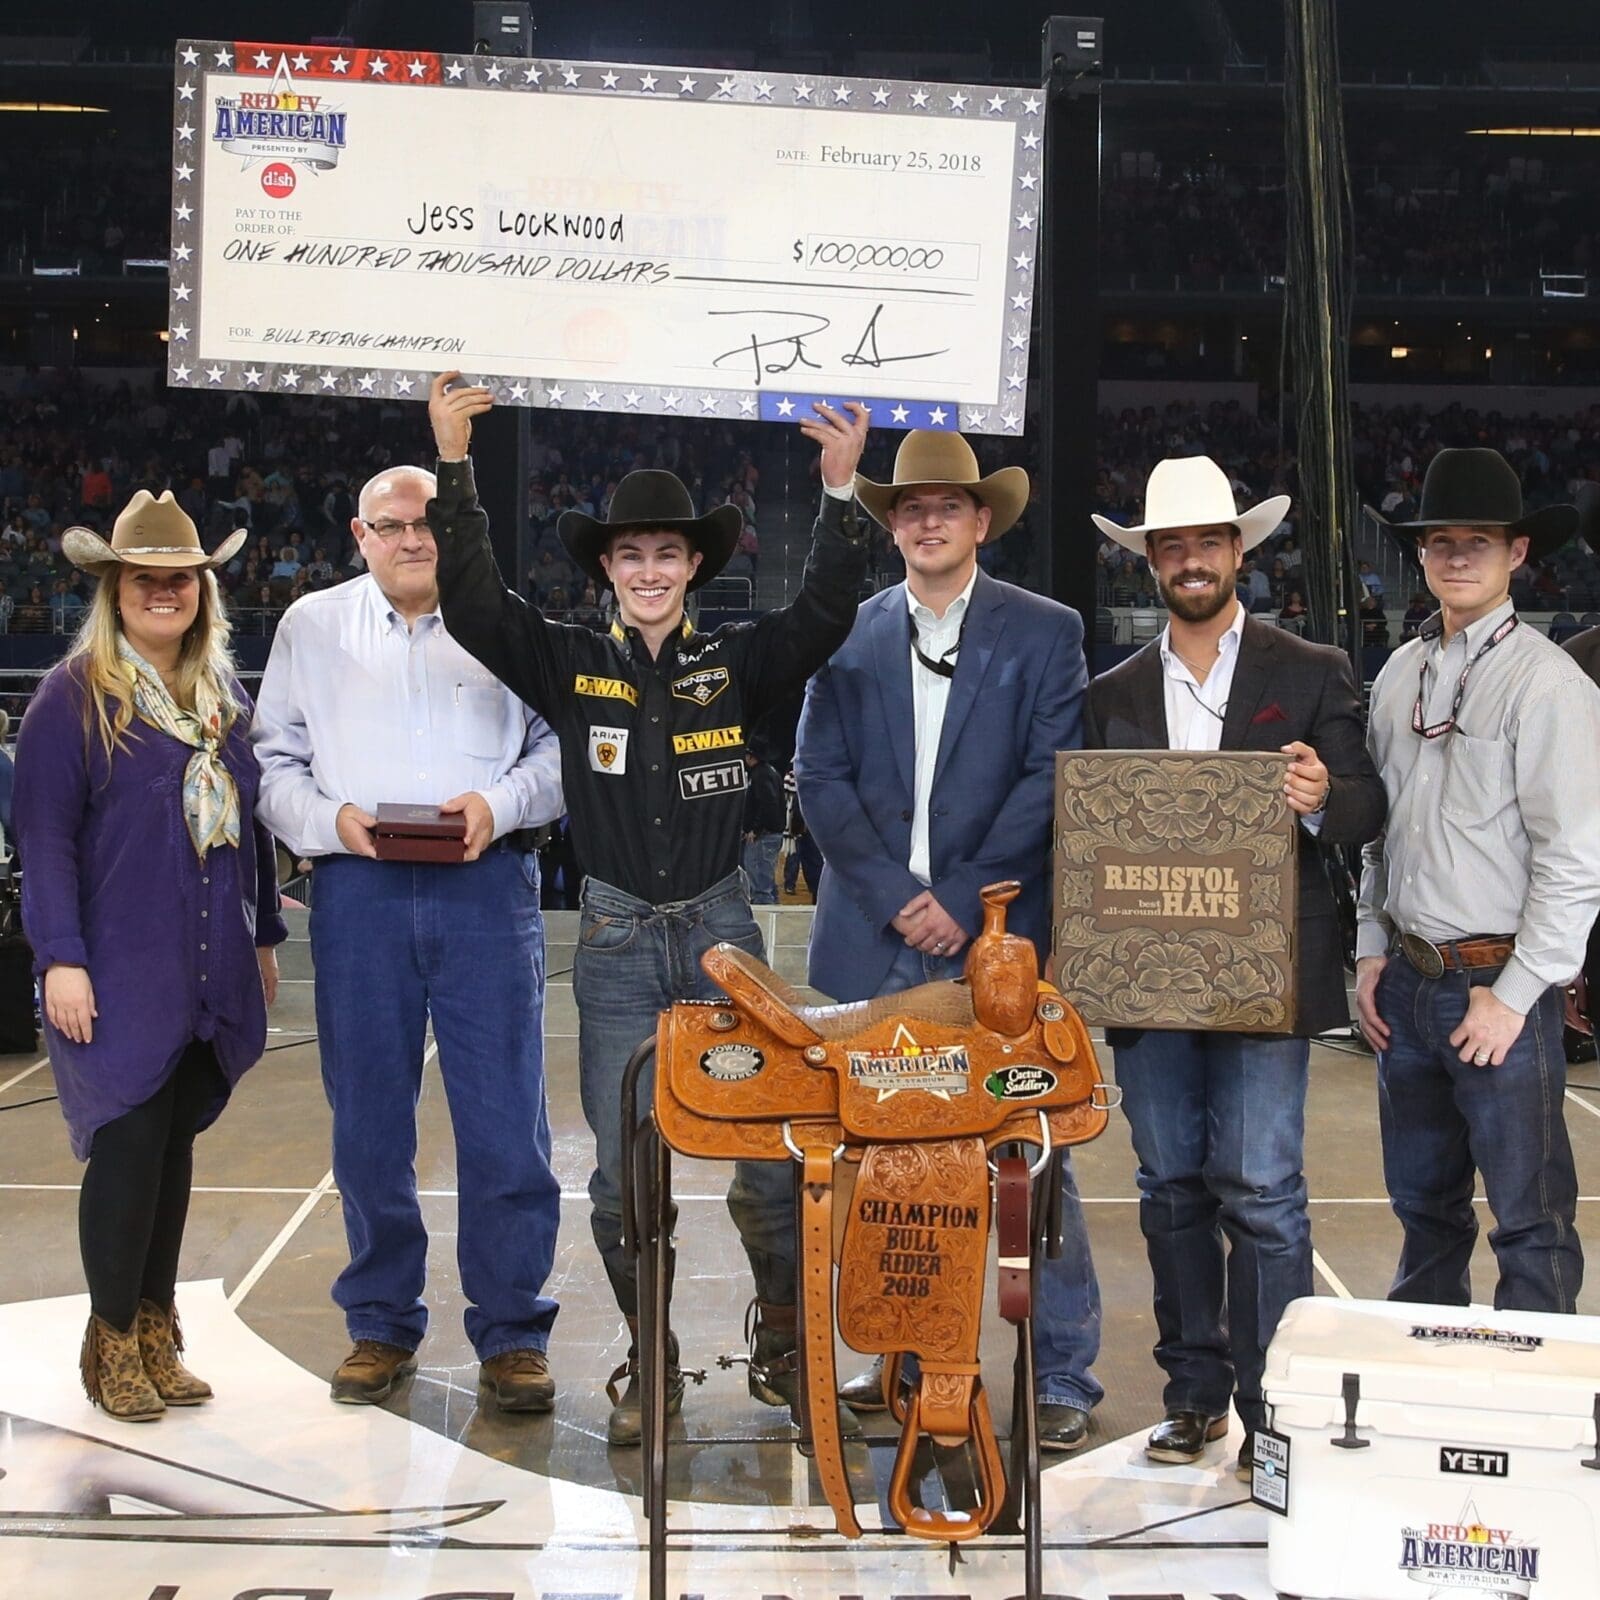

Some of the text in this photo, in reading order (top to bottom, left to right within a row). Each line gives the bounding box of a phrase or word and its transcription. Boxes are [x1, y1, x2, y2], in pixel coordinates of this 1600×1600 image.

[213, 107, 347, 148] AMERICAN
[251, 144, 309, 154] PRESENTED BY
[776, 145, 982, 172] DATE: February 25, 2018
[263, 171, 293, 187] dish
[235, 208, 303, 221] PAY TO THE
[407, 201, 475, 235] Jess
[235, 223, 296, 236] ORDER OF:
[223, 239, 670, 284] ONE HUNDRED THOUSAND DOLLARS
[228, 326, 254, 338] FOR:
[262, 327, 468, 353] BULL RIDING CHAMPION
[591, 731, 626, 741] ARIAT
[683, 765, 740, 793] YETI
[1104, 865, 1239, 893] RESISTOL
[1102, 891, 1241, 918] all-around HATS
[1138, 899, 1161, 908] best
[707, 1044, 760, 1056] COWBOY
[848, 1050, 970, 1079] AMERICAN
[1008, 1068, 1043, 1083] Cactus
[1003, 1079, 1049, 1095] Saddlery
[860, 1200, 979, 1229] CHAMPION
[886, 1227, 939, 1253] BULL
[879, 1252, 941, 1276] RIDER
[882, 1276, 931, 1297] 2018
[1407, 1325, 1545, 1347] AMERICAN
[1262, 1438, 1279, 1452] YETI
[1443, 1451, 1504, 1473] YETI
[1398, 1537, 1541, 1582] AMERICAN
[1459, 1573, 1510, 1585] STADIUM
